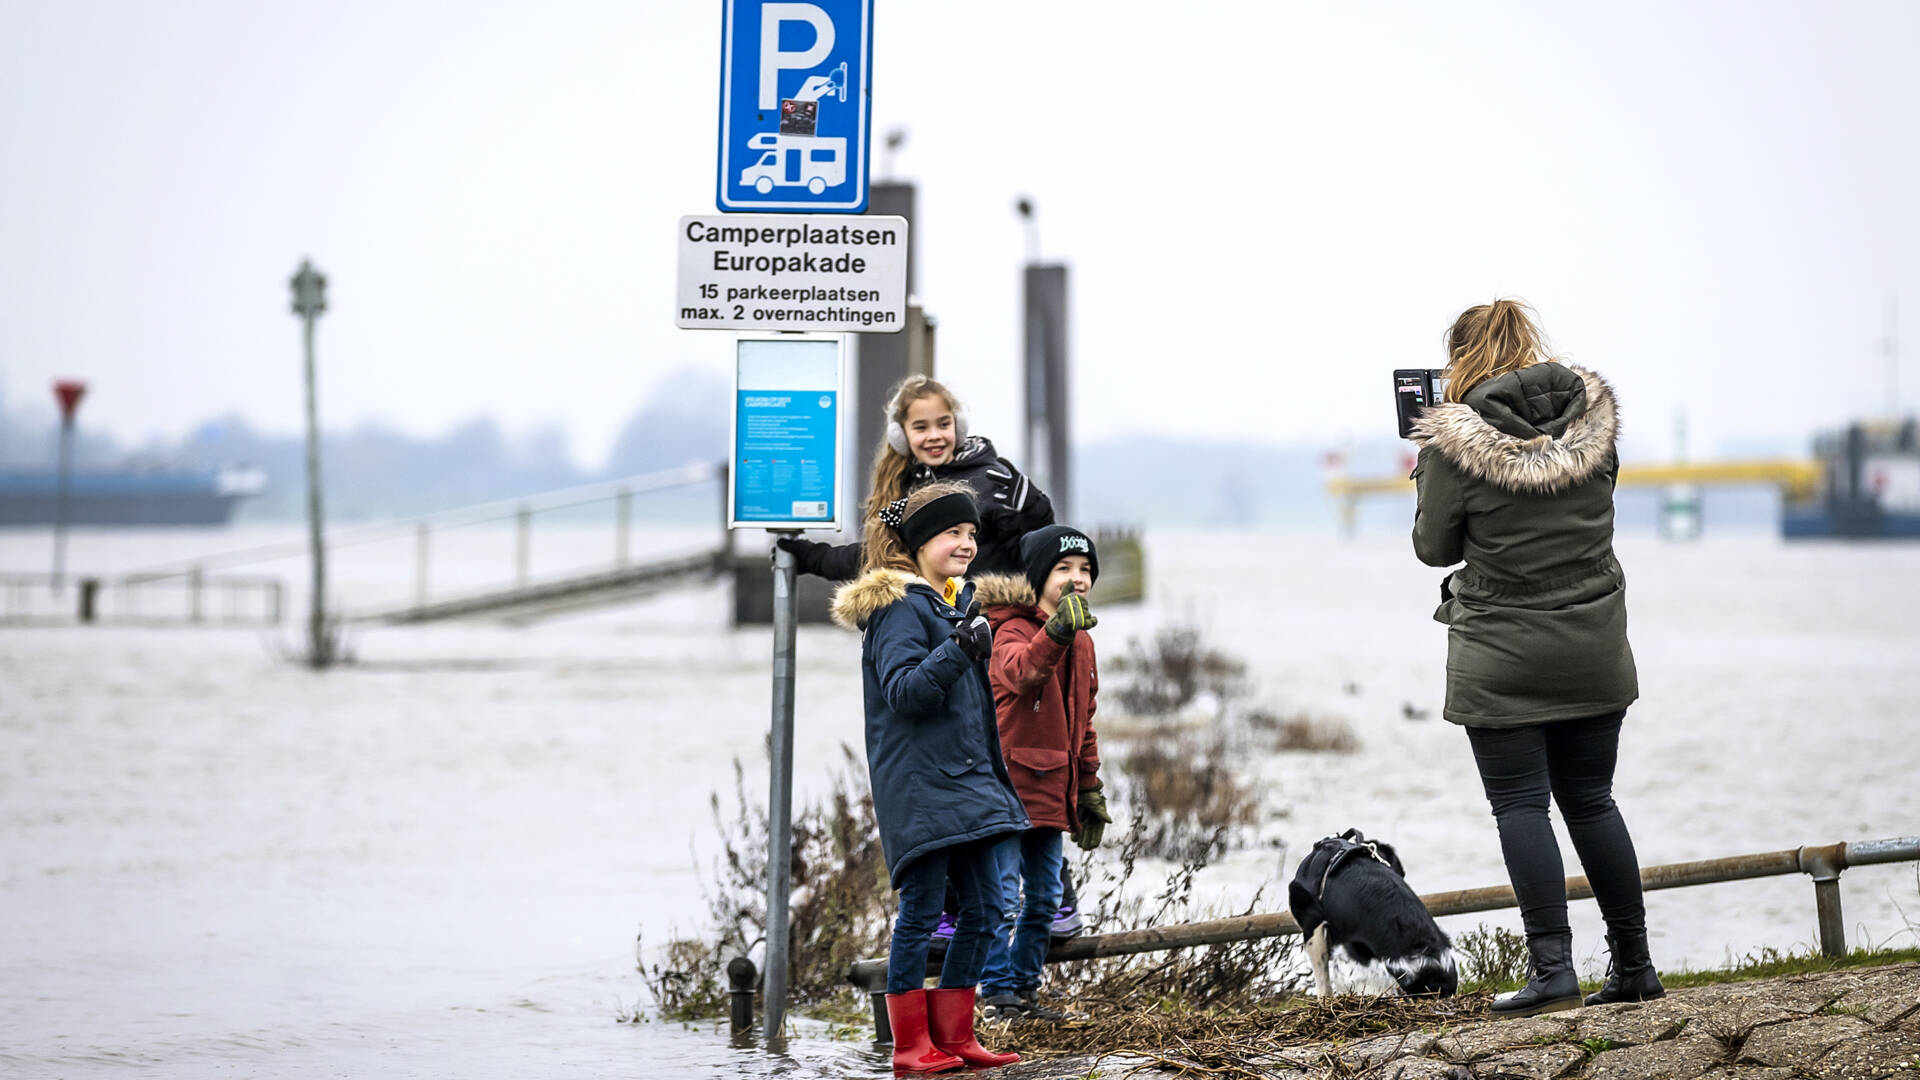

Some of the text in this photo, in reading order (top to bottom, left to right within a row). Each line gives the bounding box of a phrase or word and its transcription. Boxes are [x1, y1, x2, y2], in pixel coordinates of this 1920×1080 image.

[759, 2, 836, 110] P
[686, 221, 896, 247] Camperplaatsen
[713, 250, 866, 276] Europakade
[699, 283, 880, 303] 15 parkeerplaatsen
[681, 304, 896, 326] max. 2 overnachtingen
